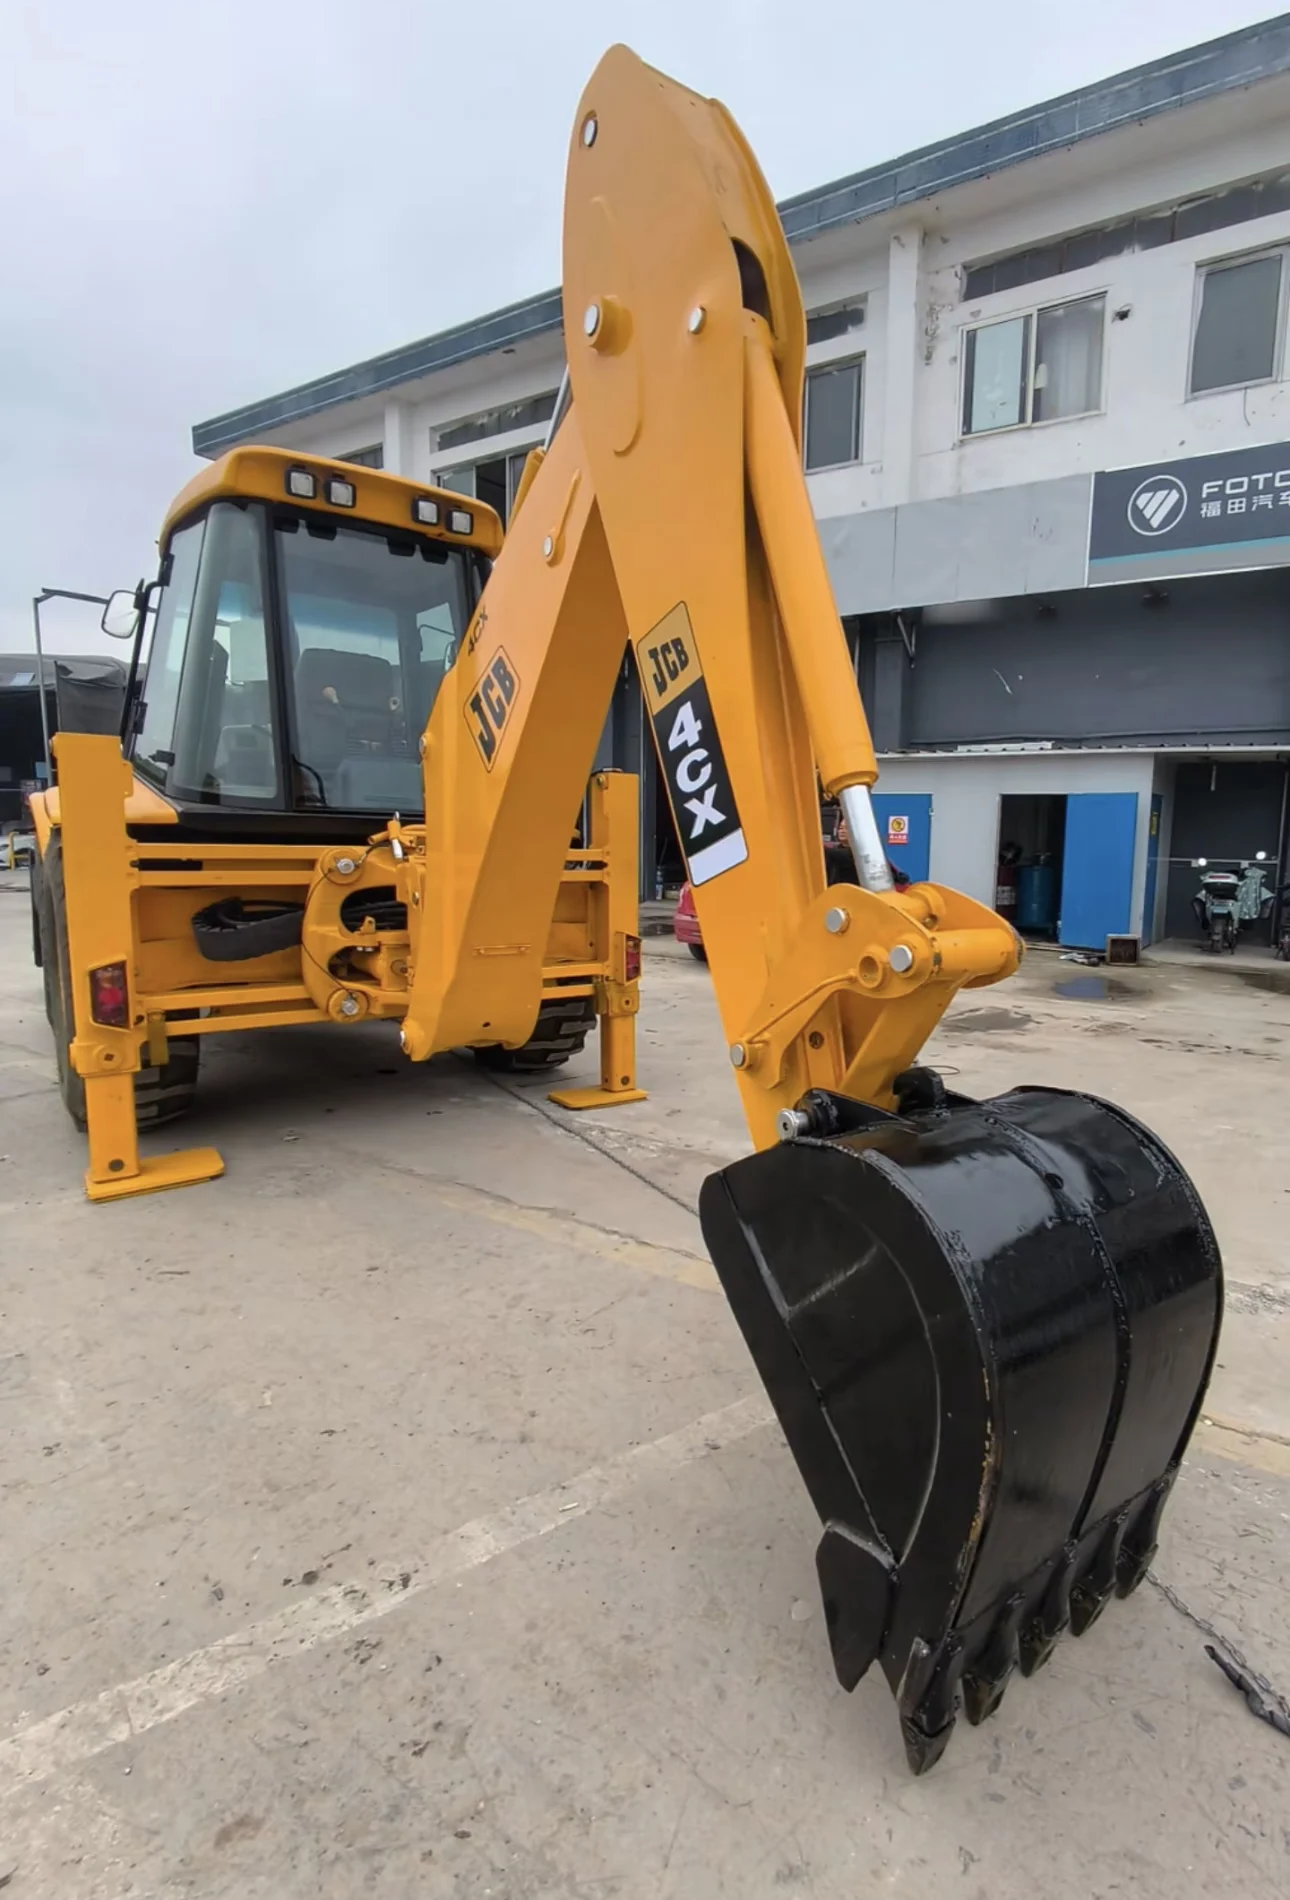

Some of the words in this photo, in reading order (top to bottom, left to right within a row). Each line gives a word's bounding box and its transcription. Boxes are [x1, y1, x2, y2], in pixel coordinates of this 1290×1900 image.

[470, 655, 516, 763] JCB
[648, 636, 690, 697] JCB
[667, 700, 727, 839] 4CX
